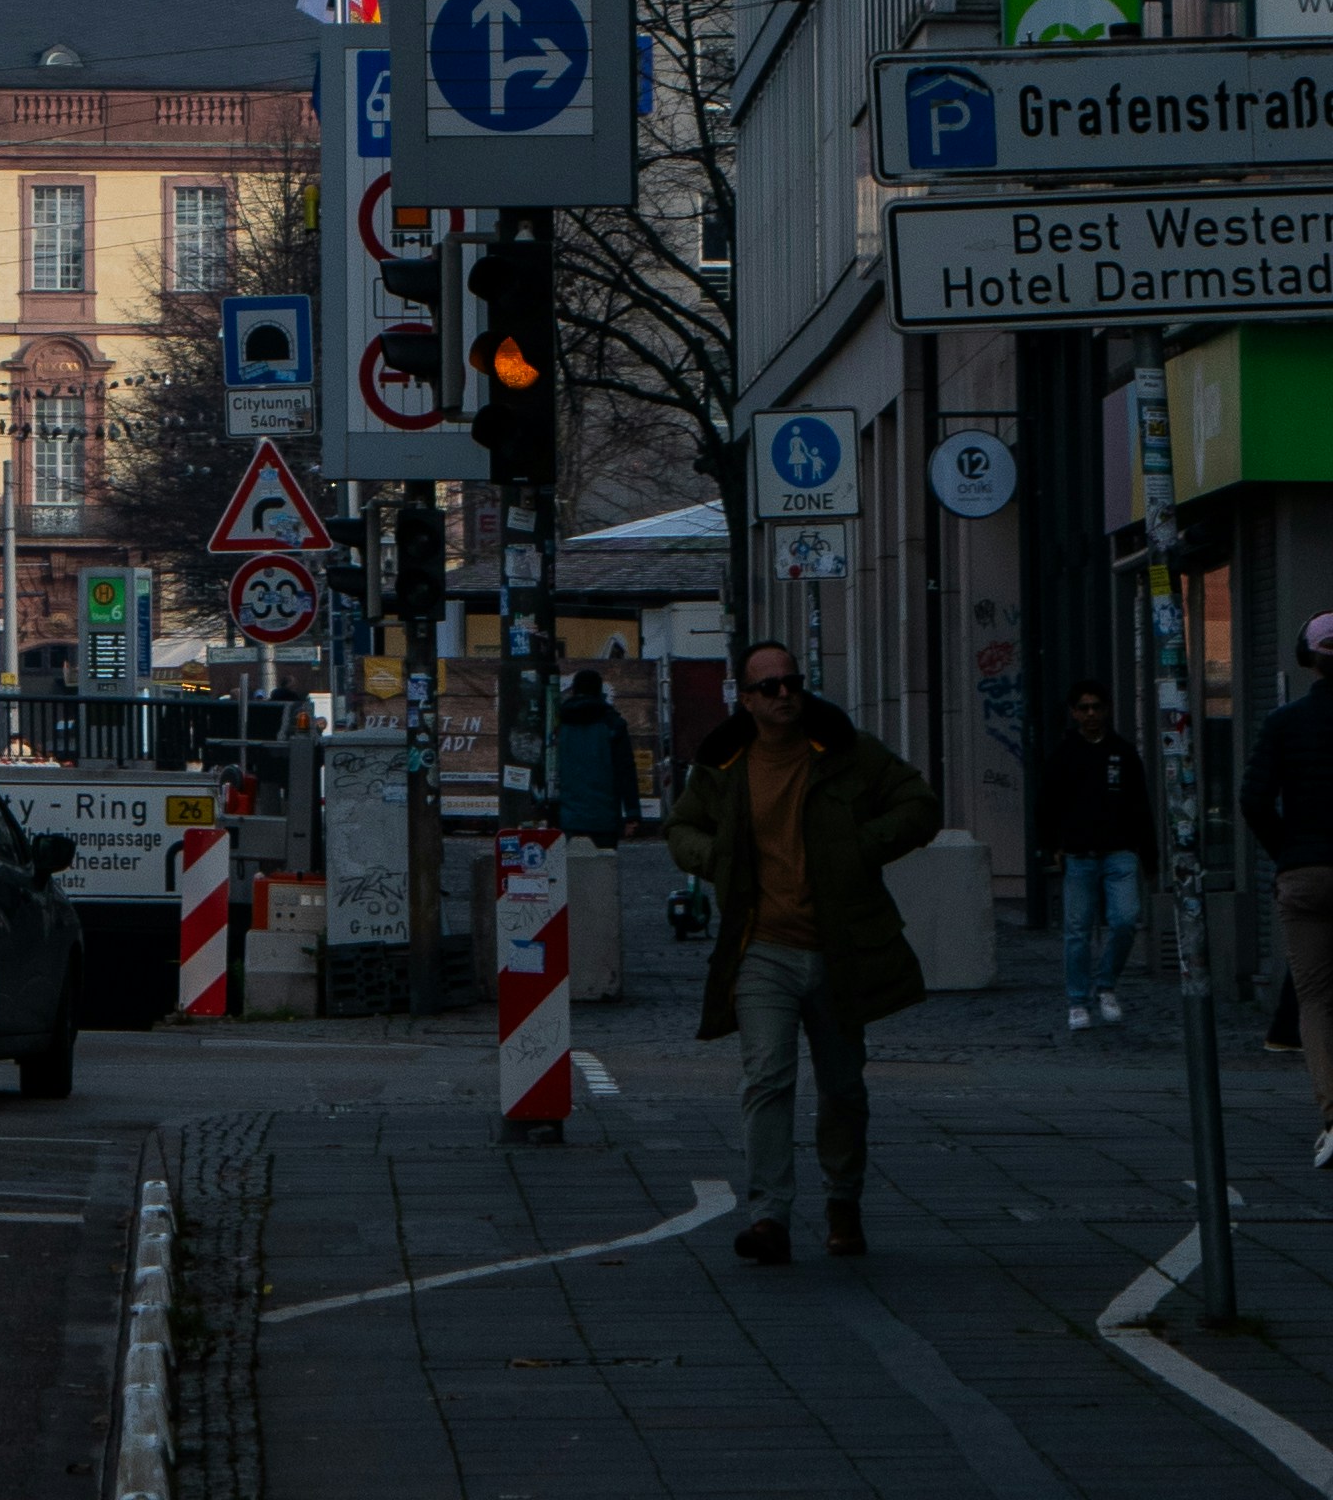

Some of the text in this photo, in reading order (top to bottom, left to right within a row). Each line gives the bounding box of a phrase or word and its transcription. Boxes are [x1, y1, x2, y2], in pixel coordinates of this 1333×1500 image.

[1013, 213, 1120, 254] Best
[943, 252, 1332, 307] Hotel Darmstad
[233, 395, 307, 413] Citytunnel
[783, 493, 833, 511] ZONE
[111, 604, 123, 620] 6
[76, 793, 147, 826] Ring
[179, 801, 202, 820] 26
